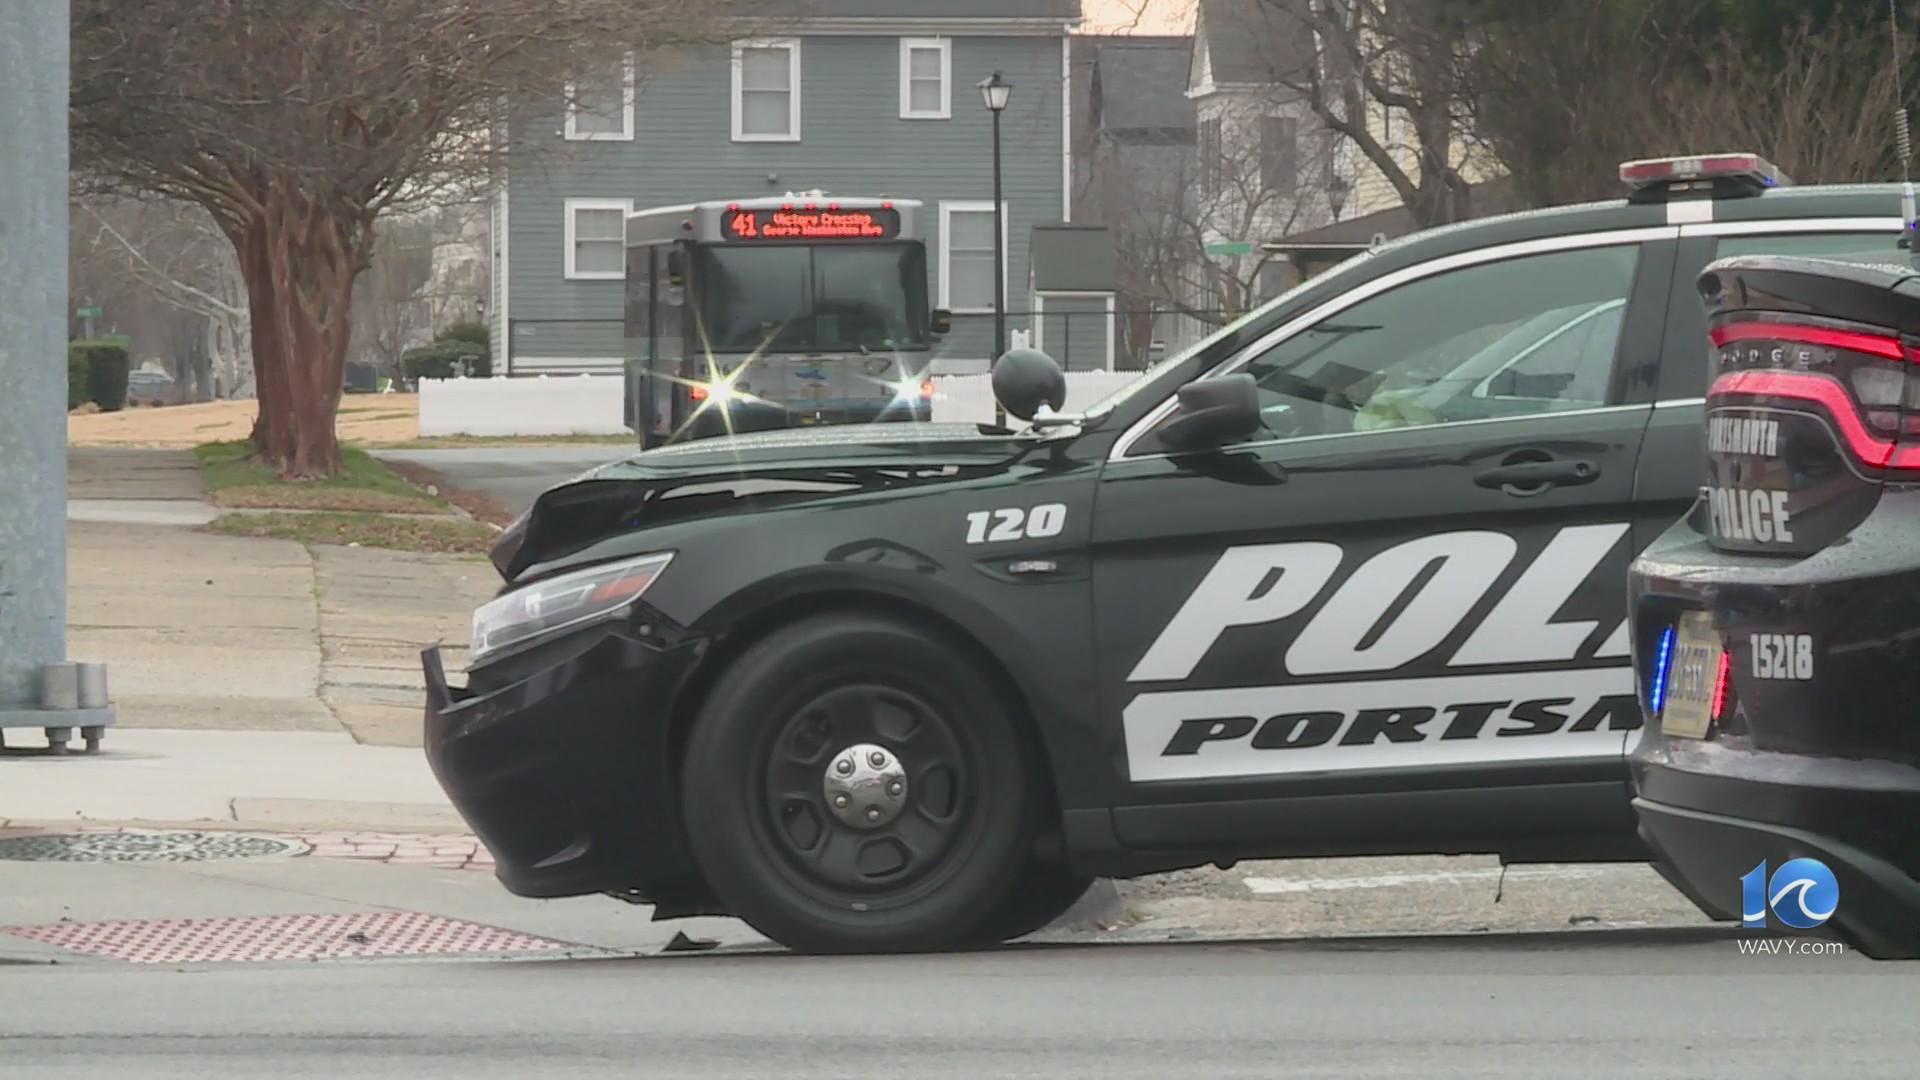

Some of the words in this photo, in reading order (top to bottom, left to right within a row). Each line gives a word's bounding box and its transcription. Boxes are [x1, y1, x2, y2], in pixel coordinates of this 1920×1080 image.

[732, 213, 757, 236] 41
[773, 213, 818, 225] Victory
[966, 503, 1067, 544] 120
[1708, 486, 1793, 543] POLICE
[1750, 634, 1814, 680] 15218
